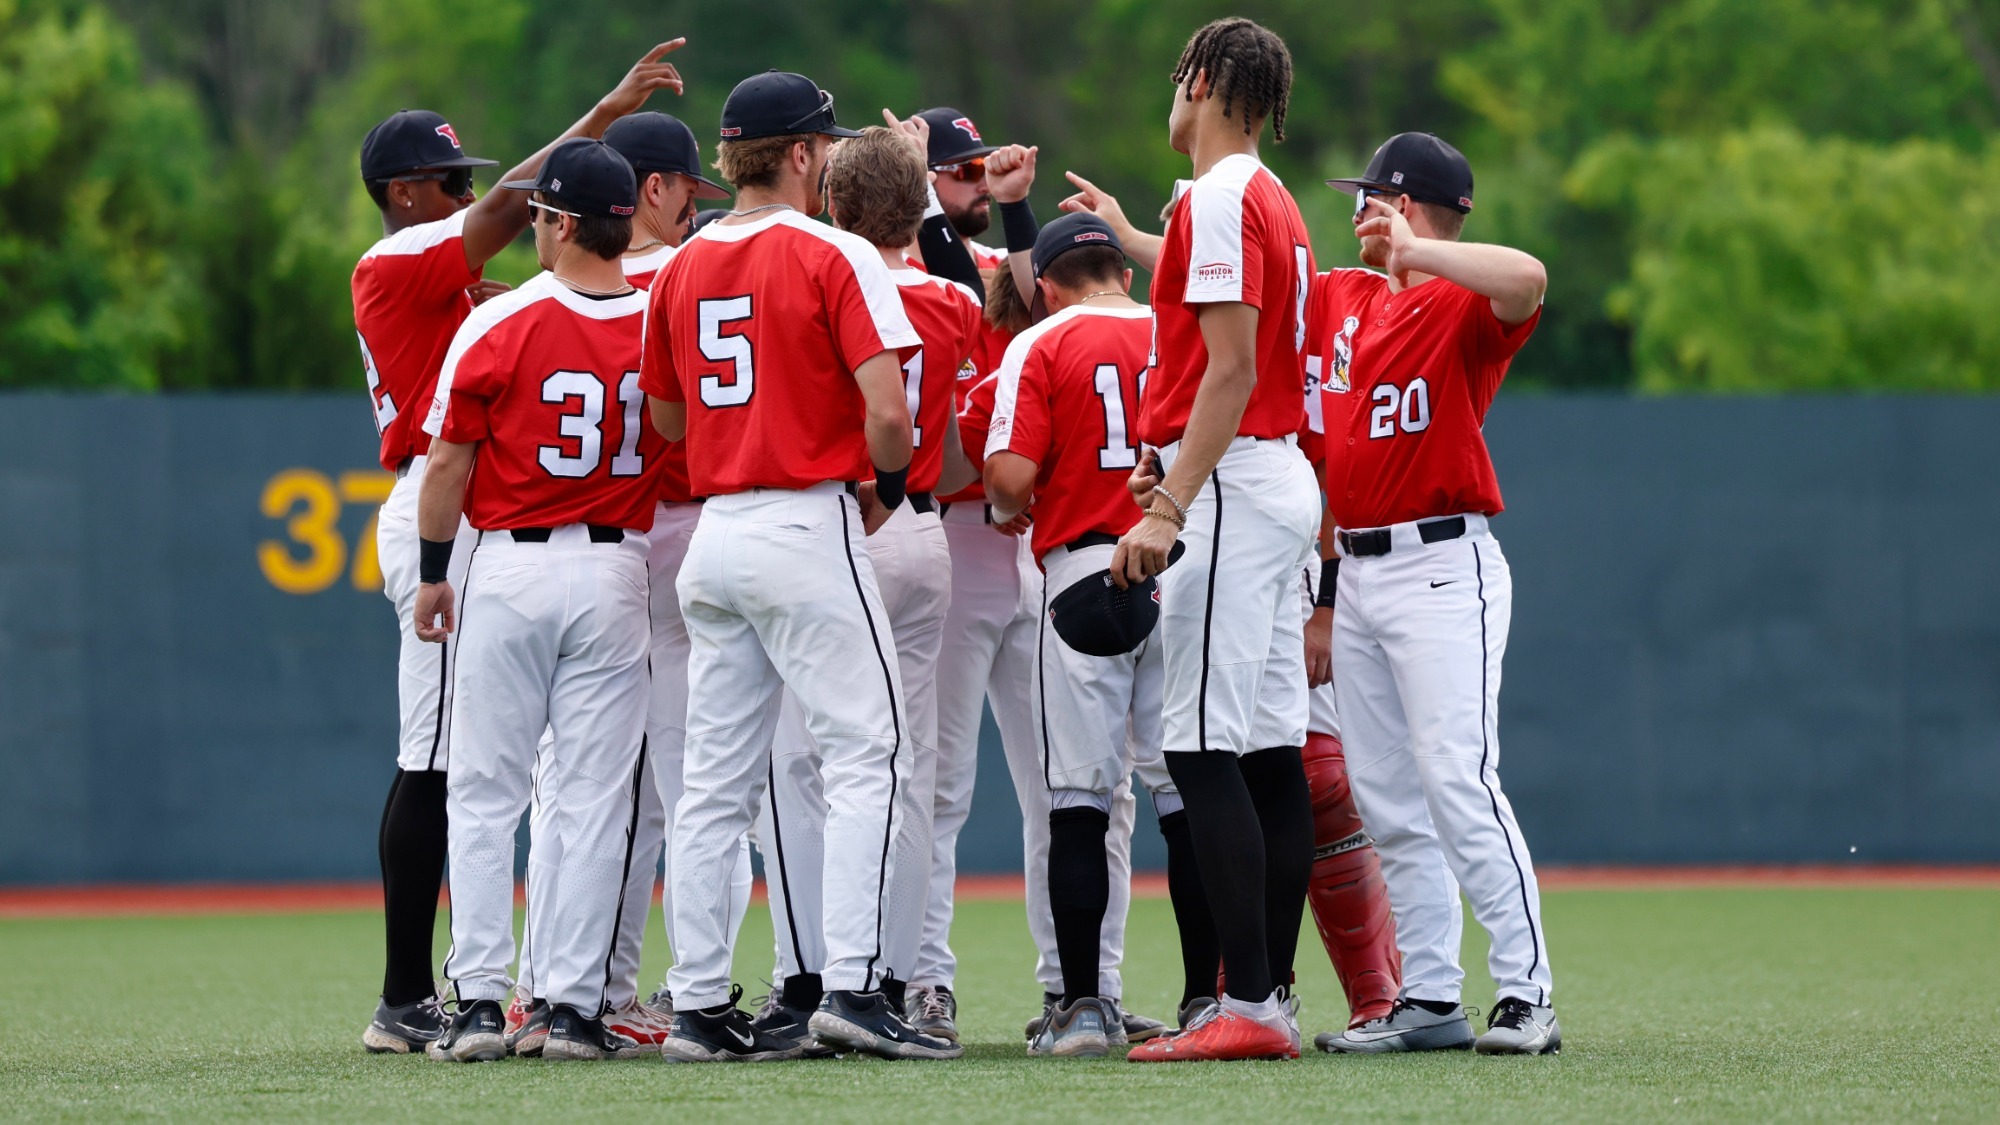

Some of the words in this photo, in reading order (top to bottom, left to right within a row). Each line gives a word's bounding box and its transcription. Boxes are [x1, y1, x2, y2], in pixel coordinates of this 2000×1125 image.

[1198, 268, 1233, 276] HORIZON
[697, 293, 755, 410] 5
[537, 369, 646, 479] 31
[1093, 363, 1150, 471] 1
[1369, 375, 1431, 440] 20
[1315, 834, 1365, 858] STON
